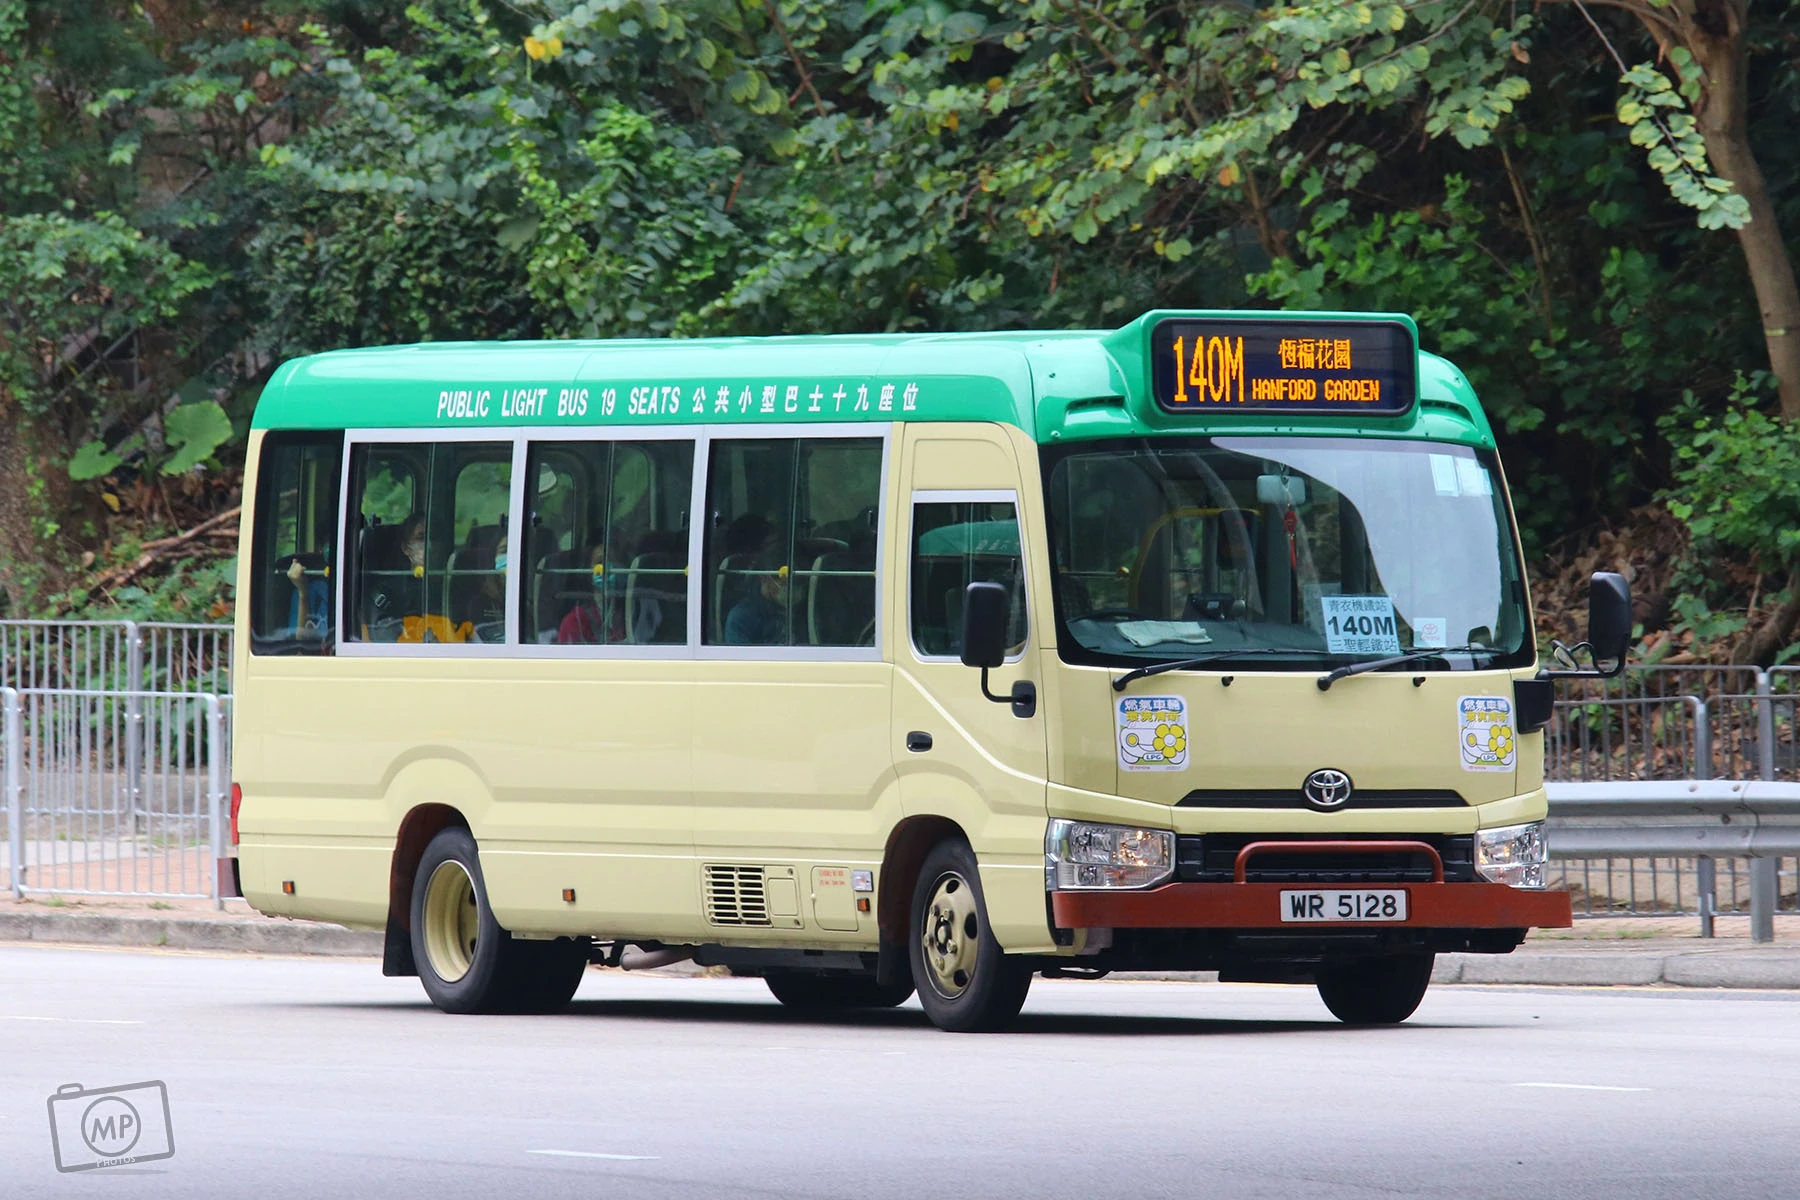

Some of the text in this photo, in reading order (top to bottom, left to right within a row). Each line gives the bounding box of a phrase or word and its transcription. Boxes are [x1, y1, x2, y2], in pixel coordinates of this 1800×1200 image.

[1173, 335, 1245, 402] 140M
[437, 386, 680, 418] PUBLIC LIGHT BUS 19 SEATS
[691, 383, 919, 414] 公共小型巴士十九座位
[1252, 378, 1380, 401] HANFORD GARDEN
[1327, 615, 1395, 636] 140M
[1291, 894, 1397, 918] WR 5128
